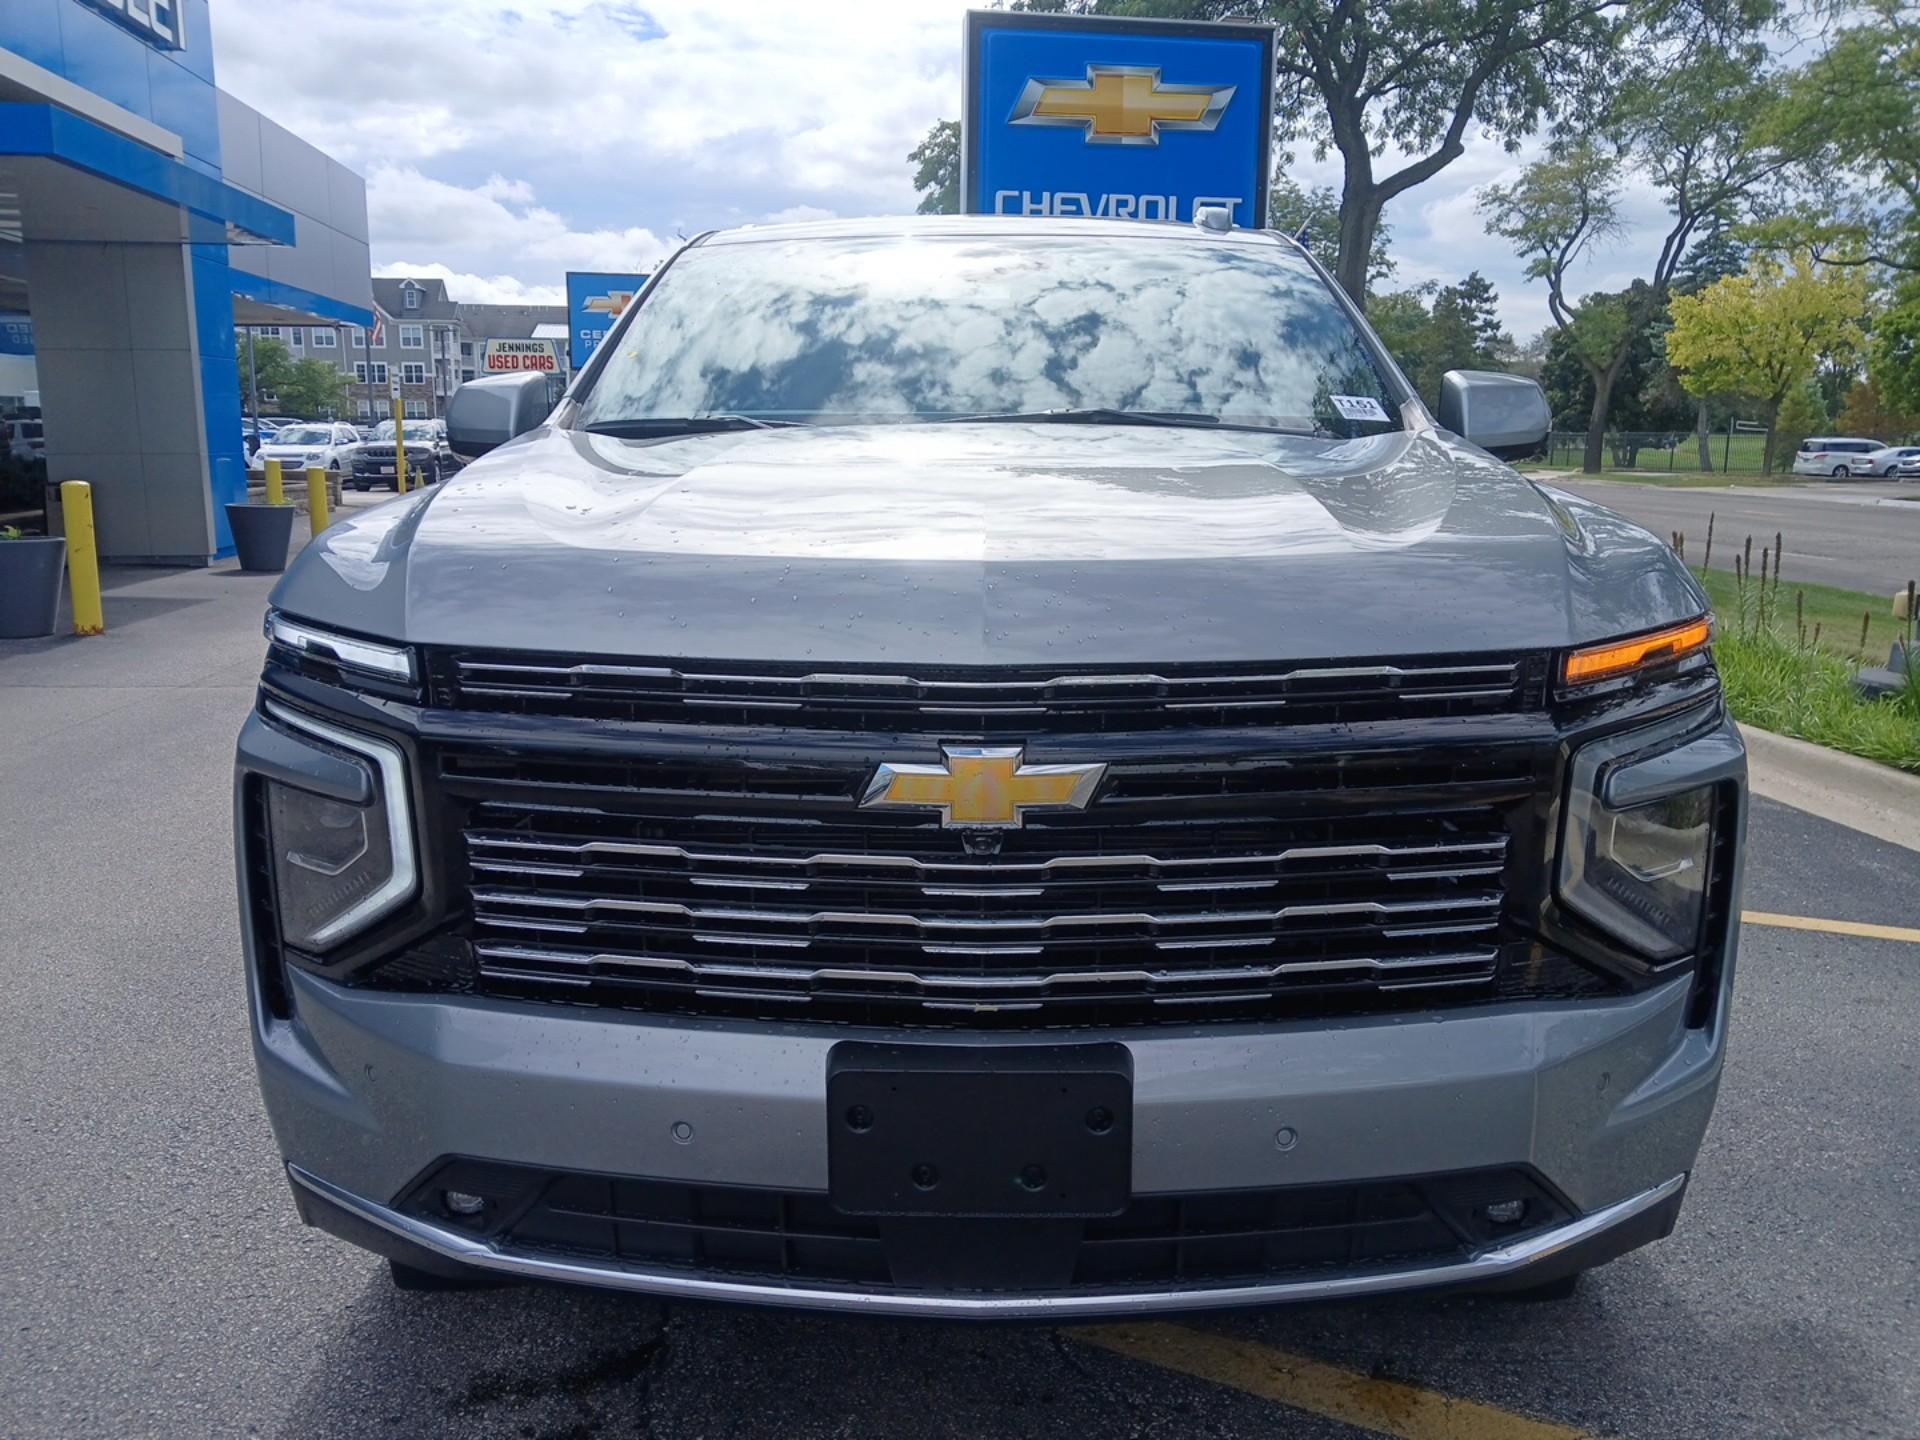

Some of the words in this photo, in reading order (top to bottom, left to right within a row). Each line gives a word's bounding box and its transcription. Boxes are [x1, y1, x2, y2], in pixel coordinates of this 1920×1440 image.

[495, 342, 545, 353] JENNINGS
[487, 354, 519, 369] USED
[522, 355, 554, 370] CARS
